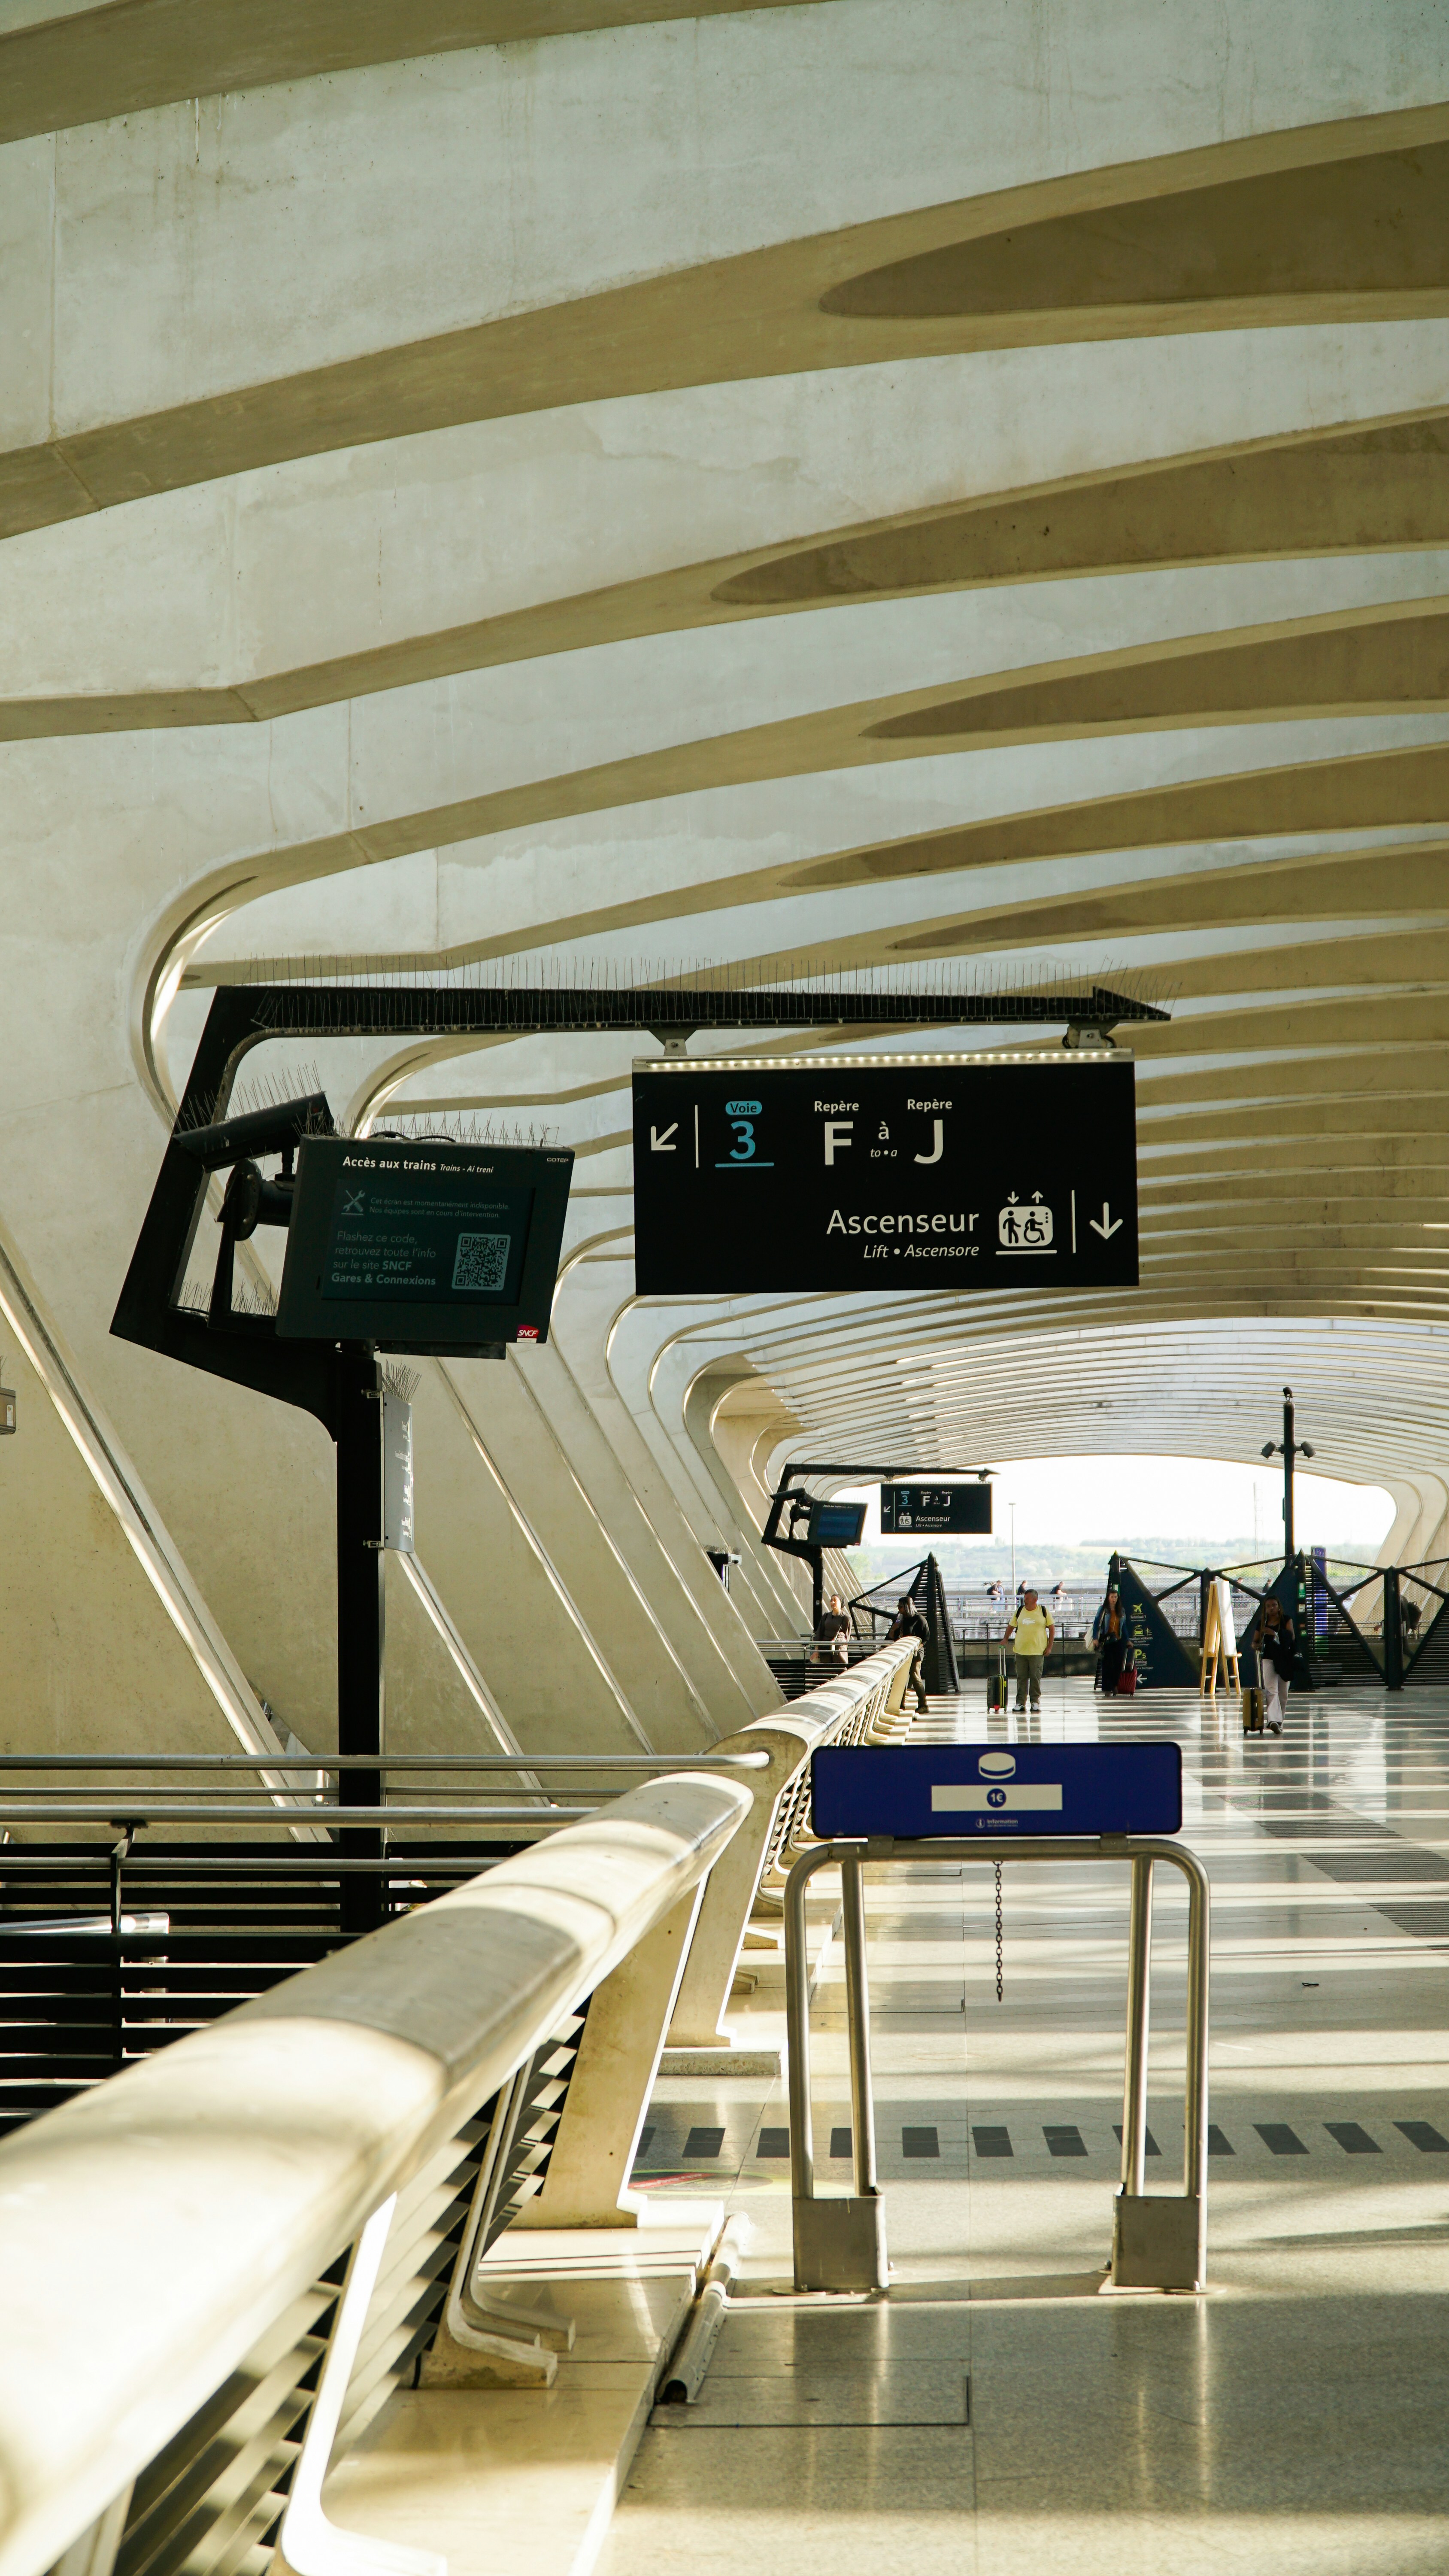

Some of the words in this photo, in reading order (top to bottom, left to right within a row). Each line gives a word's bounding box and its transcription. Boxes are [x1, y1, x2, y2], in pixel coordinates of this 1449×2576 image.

[731, 1103, 757, 1115] Voie
[815, 1101, 859, 1114] Repère
[908, 1099, 952, 1112] Repère
[730, 1121, 755, 1159] 3
[825, 1121, 853, 1165] F
[879, 1121, 889, 1139] à
[914, 1120, 943, 1163] J
[871, 1149, 880, 1157] to
[891, 1148, 897, 1157] a
[343, 1156, 376, 1167] Accès
[403, 1160, 436, 1170] trains
[827, 1210, 979, 1234] Ascenseur
[337, 1231, 373, 1241] Flashez
[391, 1233, 417, 1244] code,
[336, 1247, 380, 1255] retrouvez
[384, 1248, 409, 1256] toute
[864, 1245, 889, 1258] Lift
[904, 1245, 979, 1257] Ascensore
[351, 1259, 359, 1268] le
[363, 1261, 379, 1269] site
[382, 1261, 412, 1270] SNCF
[332, 1273, 361, 1282] Gares
[365, 1274, 372, 1283] &
[376, 1274, 435, 1285] Connexions
[902, 1495, 908, 1504] 3
[923, 1496, 930, 1506] F
[943, 1496, 950, 1506] J
[991, 1793, 1003, 1802] 1€
